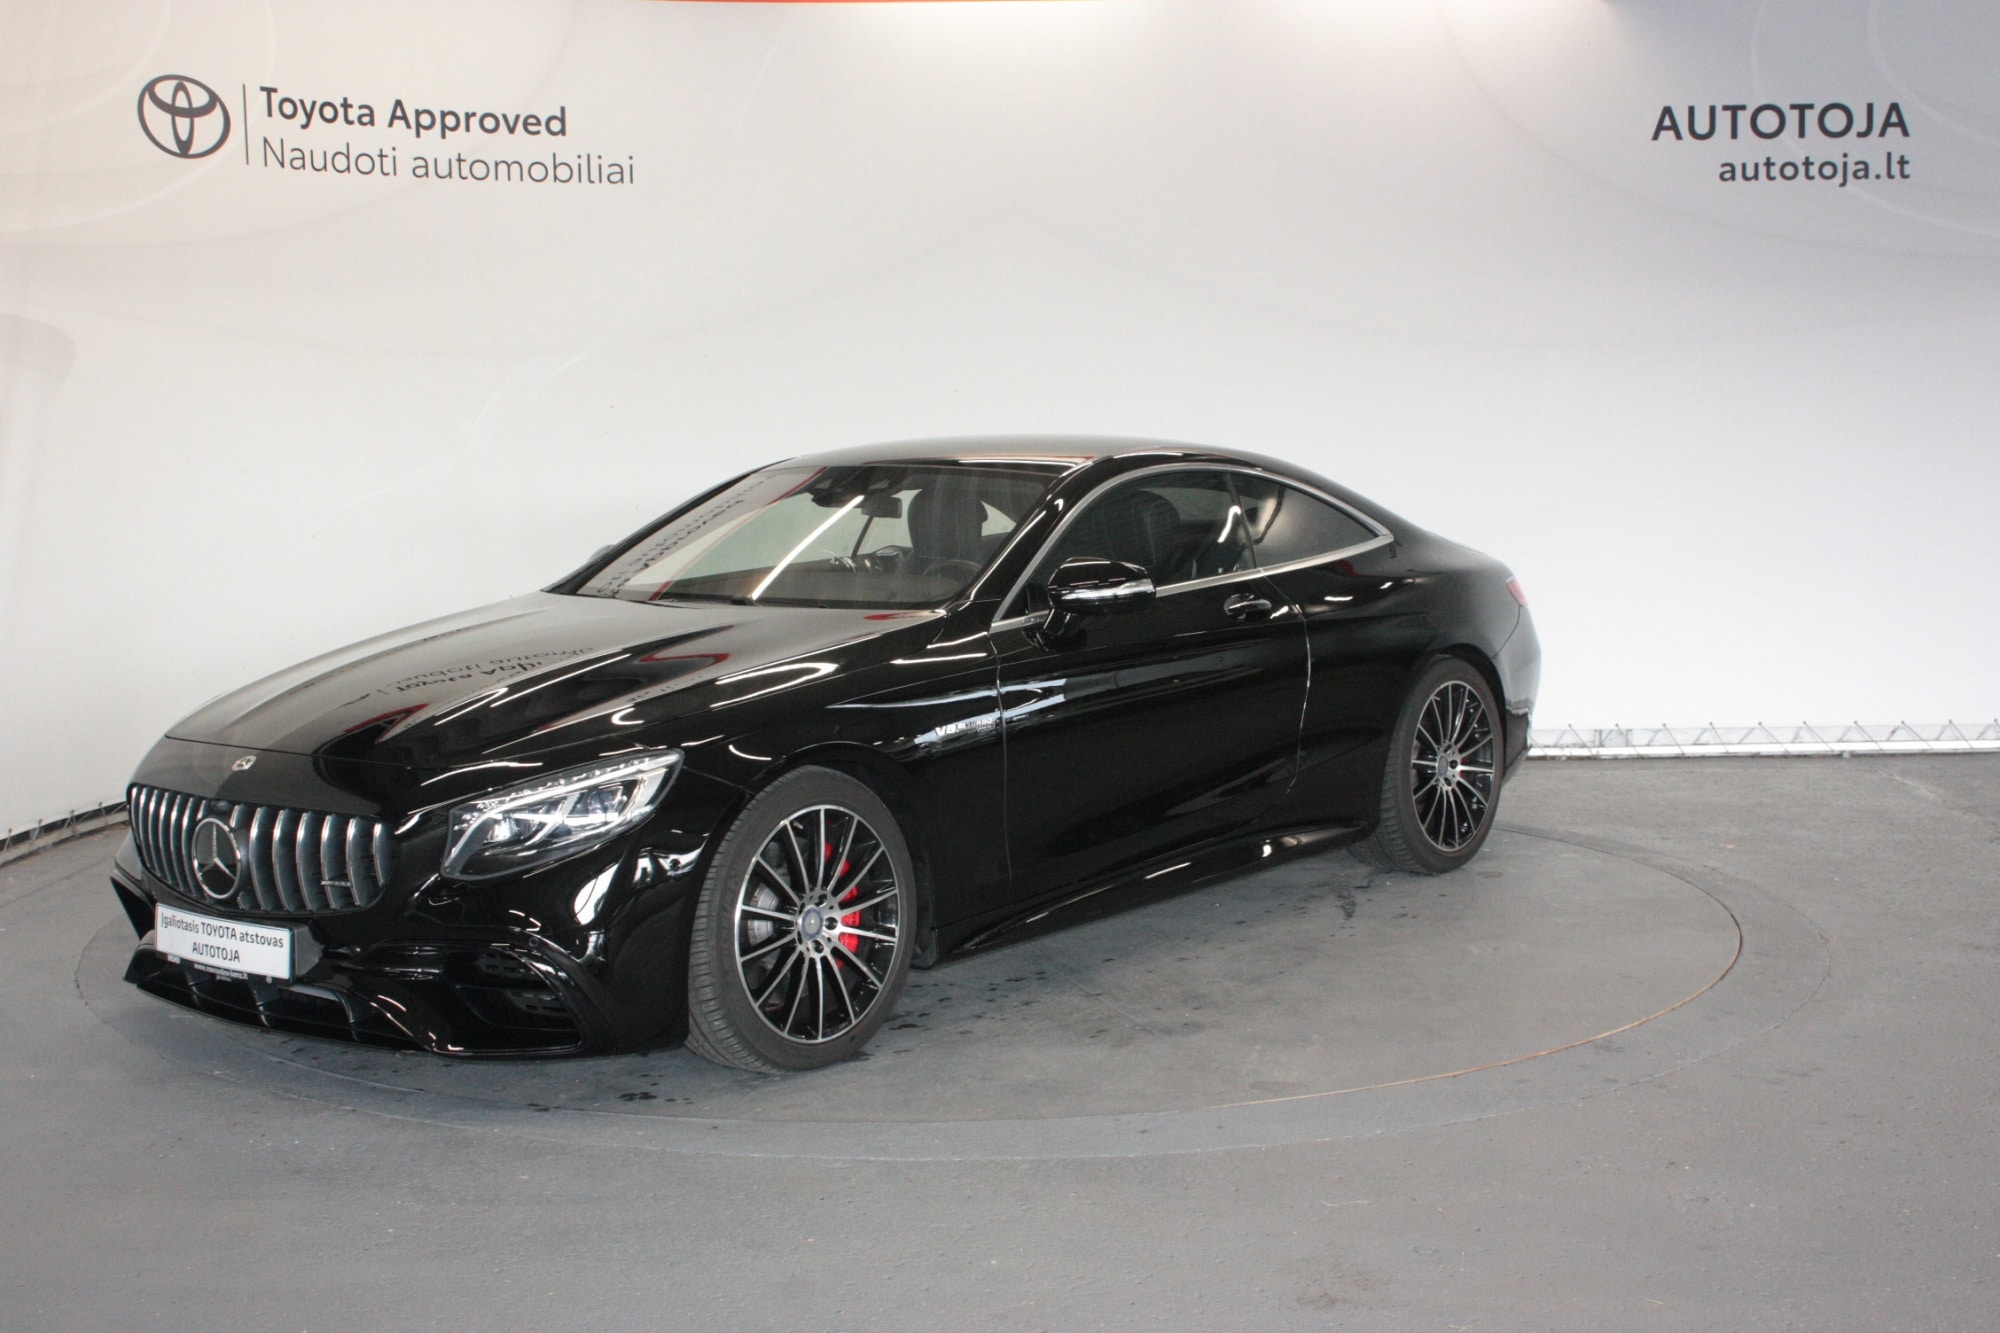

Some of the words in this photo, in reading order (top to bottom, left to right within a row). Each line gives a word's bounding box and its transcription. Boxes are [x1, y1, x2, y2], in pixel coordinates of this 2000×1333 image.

[259, 85, 375, 130] Toyota
[387, 98, 567, 140] Approved
[1651, 101, 1911, 141] AUTOTOJA
[263, 136, 397, 177] Naudoti
[412, 152, 635, 185] automobiliai
[1718, 151, 1911, 188] autotoja.lt
[193, 943, 240, 962] AUTOTOJA
[201, 922, 237, 940] TOYOTA
[239, 930, 284, 949] atstovas
